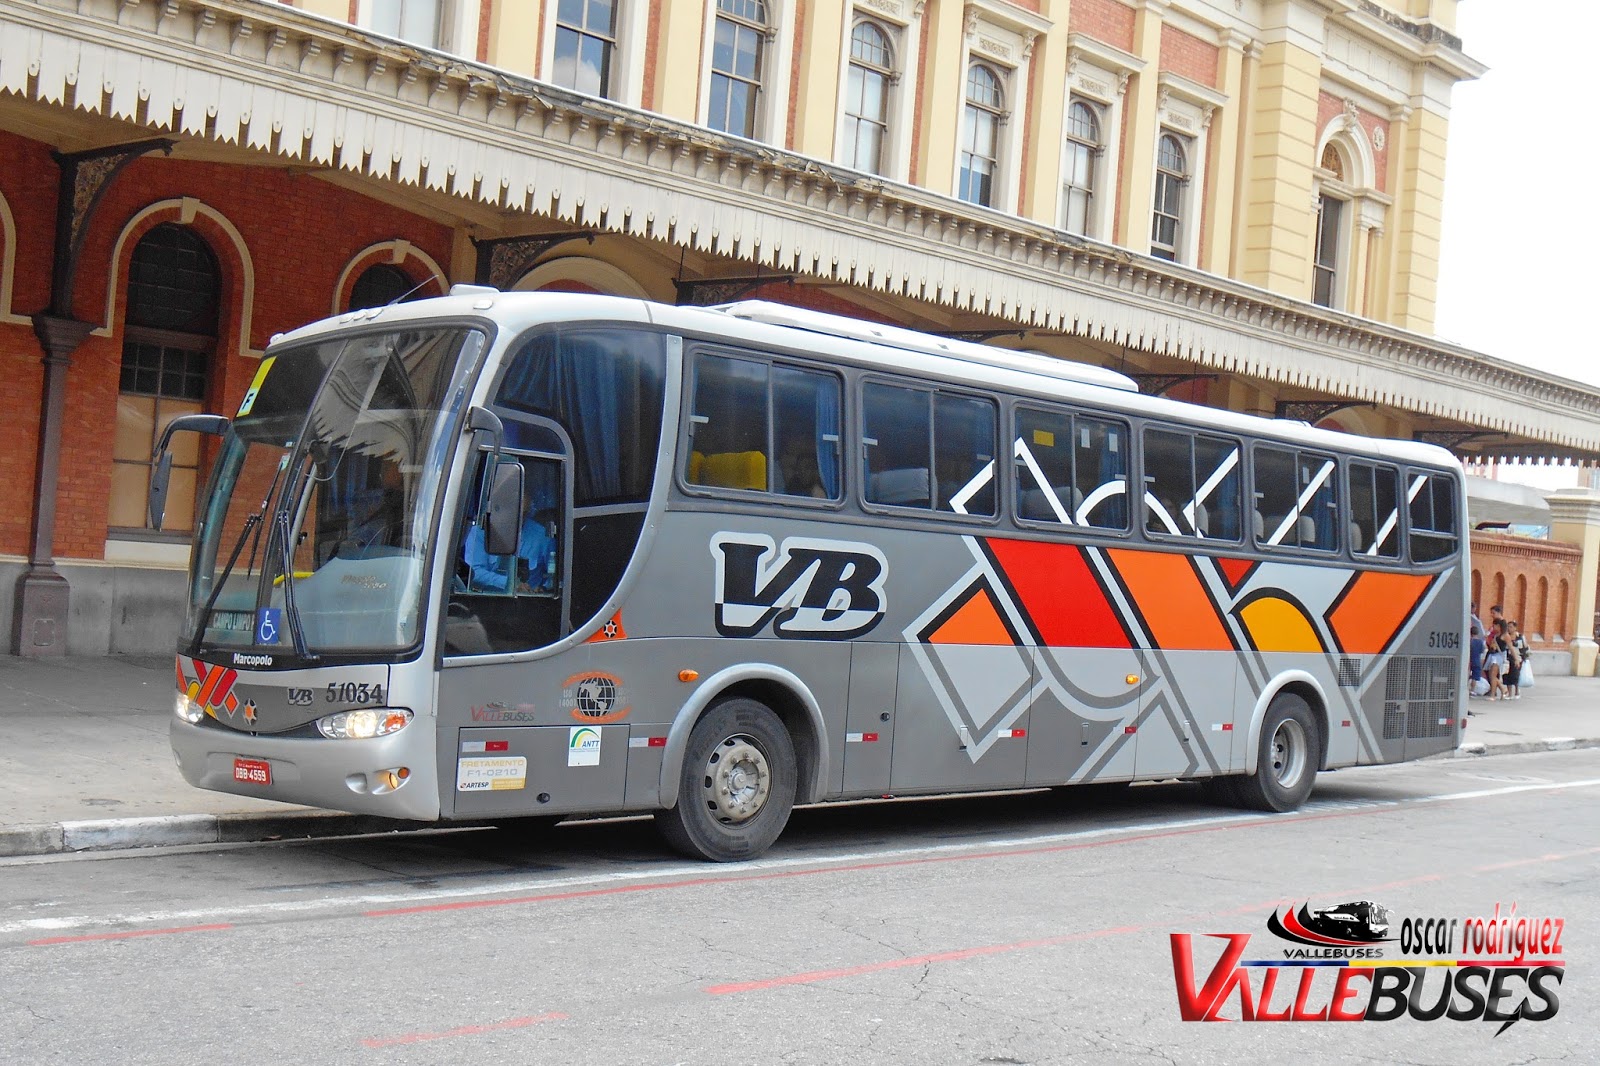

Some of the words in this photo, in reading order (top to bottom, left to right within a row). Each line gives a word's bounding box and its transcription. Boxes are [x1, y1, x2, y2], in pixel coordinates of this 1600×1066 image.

[709, 531, 889, 641] VB
[213, 612, 233, 630] CAMPO
[1428, 631, 1460, 649] 51034
[233, 653, 273, 666] Marcopolo
[287, 687, 314, 706] VB
[325, 682, 383, 704] 51034
[582, 740, 600, 749] ANTT
[461, 759, 524, 767] FRETAMENTO
[467, 768, 518, 777] F1-0210
[466, 781, 490, 789] ARTESP
